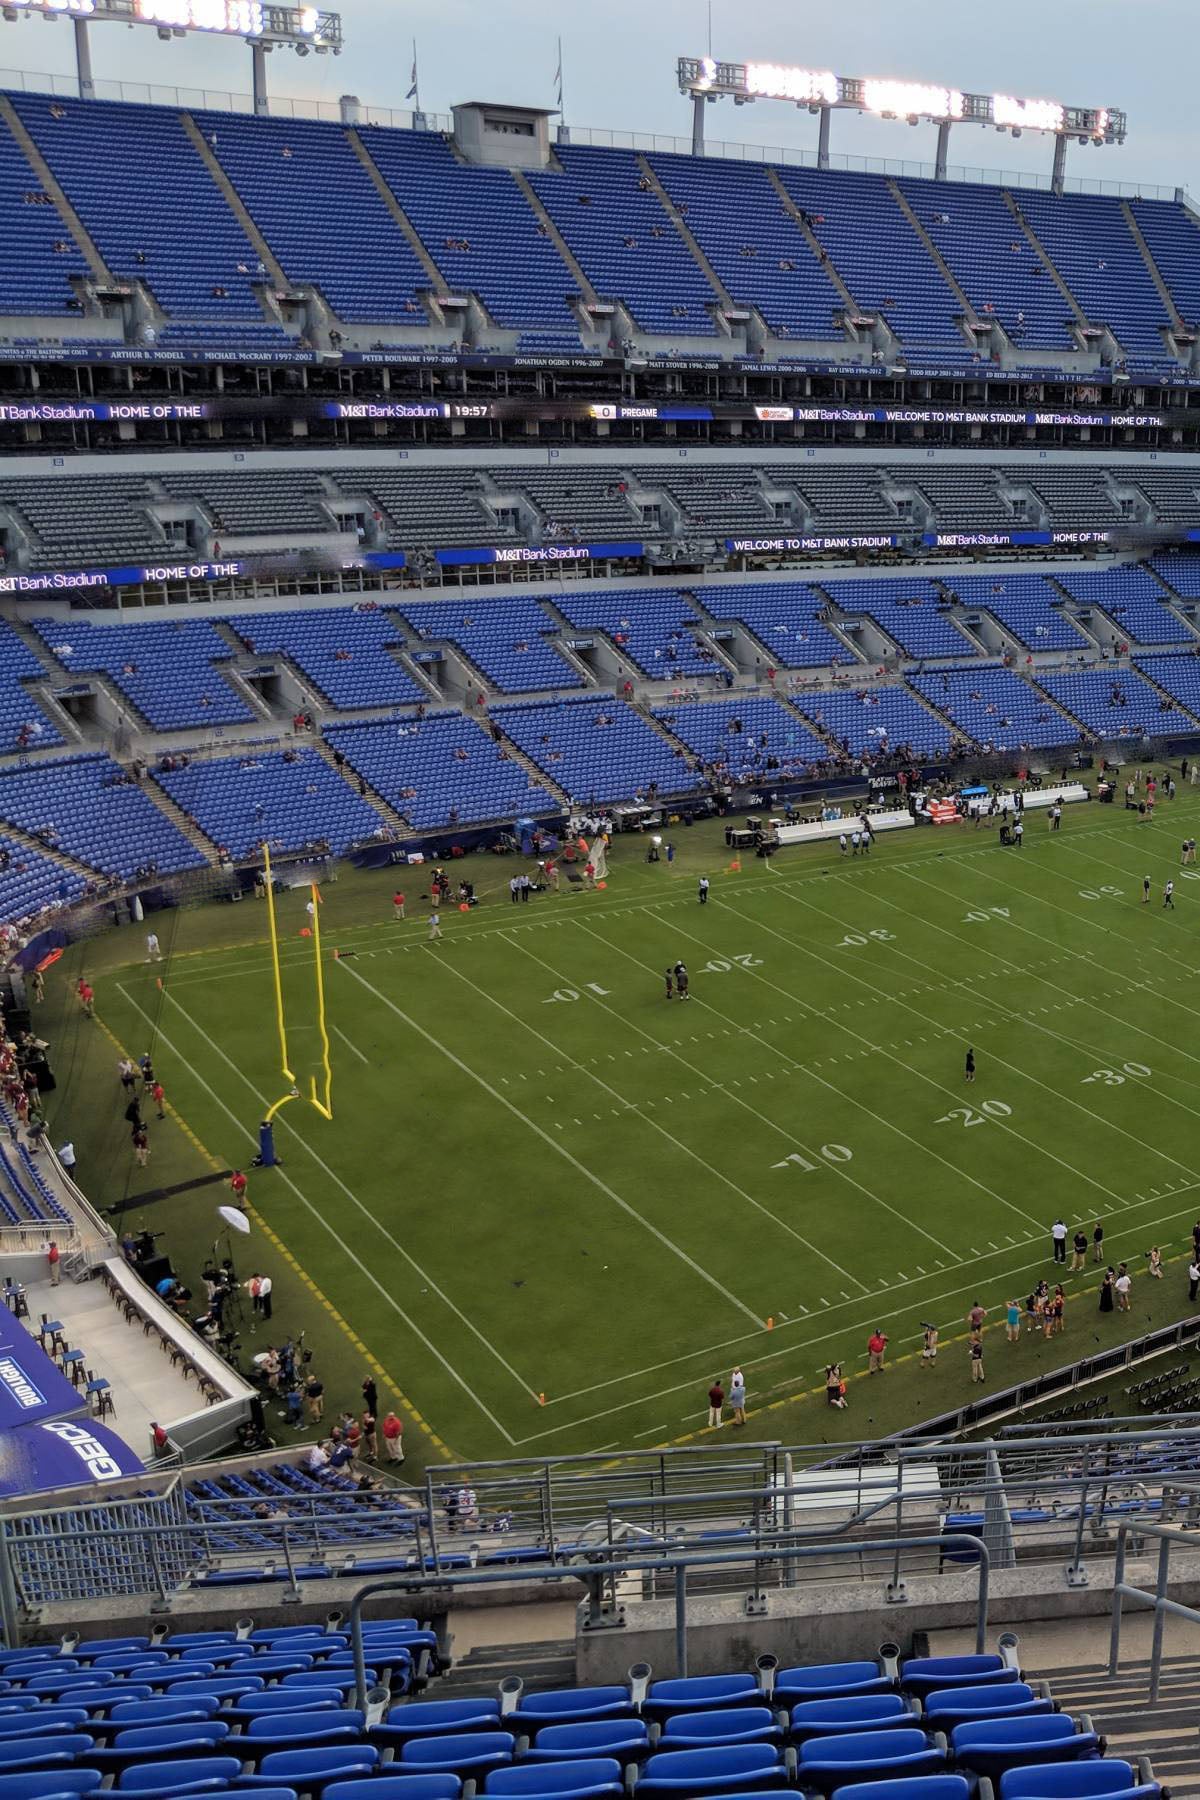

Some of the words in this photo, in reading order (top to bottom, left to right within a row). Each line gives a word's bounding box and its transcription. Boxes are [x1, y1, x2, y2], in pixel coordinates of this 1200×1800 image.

[362, 354, 382, 362] PETER
[384, 354, 420, 363] BOULWARE
[9, 407, 42, 419] Bank
[43, 407, 94, 419] Stadium
[110, 407, 149, 417] HOME
[153, 407, 172, 417] OF
[176, 407, 201, 417] THE
[341, 406, 368, 417] M&T
[369, 405, 395, 417] Bank
[396, 406, 438, 416] Stadium
[456, 407, 487, 416] 19:57
[602, 408, 609, 417] 0
[622, 409, 657, 417] PREGAME
[799, 409, 820, 419] M&T
[821, 410, 841, 419] Bank
[842, 411, 875, 420] Stadium
[886, 411, 930, 421] WELCOME
[932, 413, 944, 421] TO
[946, 413, 964, 421] M&T
[966, 413, 988, 422] BANK
[990, 414, 1026, 422] STADIUM
[1036, 414, 1055, 423] M&T
[1055, 415, 1073, 424] Bank
[1073, 415, 1102, 424] Stadium
[1136, 417, 1146, 425] OF
[734, 540, 784, 550] WELCOME
[786, 540, 800, 548] TO
[802, 539, 822, 548] M&T
[824, 538, 850, 547] BANK
[852, 537, 891, 546] STADIUM
[937, 535, 958, 545] M&T
[959, 535, 978, 544] Bank
[978, 535, 1009, 544] Stadium
[1053, 534, 1077, 542] HOME
[495, 550, 522, 561] M&T
[523, 549, 549, 560] Bank
[549, 547, 589, 558] Stadium
[146, 567, 186, 580] HOME
[190, 566, 208, 577] OF
[212, 564, 238, 575] THE
[0, 578, 18, 591] &T
[20, 577, 53, 590] Bank
[54, 573, 107, 587] Stadium
[1079, 885, 1125, 900] 50
[968, 907, 1011, 922] 40
[845, 929, 896, 946] 30
[706, 954, 764, 972] 20
[553, 983, 612, 1002] 10
[1093, 1062, 1151, 1085] 30
[949, 1100, 1012, 1127] 20
[786, 1144, 852, 1172] 10
[14, 1385, 42, 1406] BUD
[41, 1422, 122, 1480] GEICO
